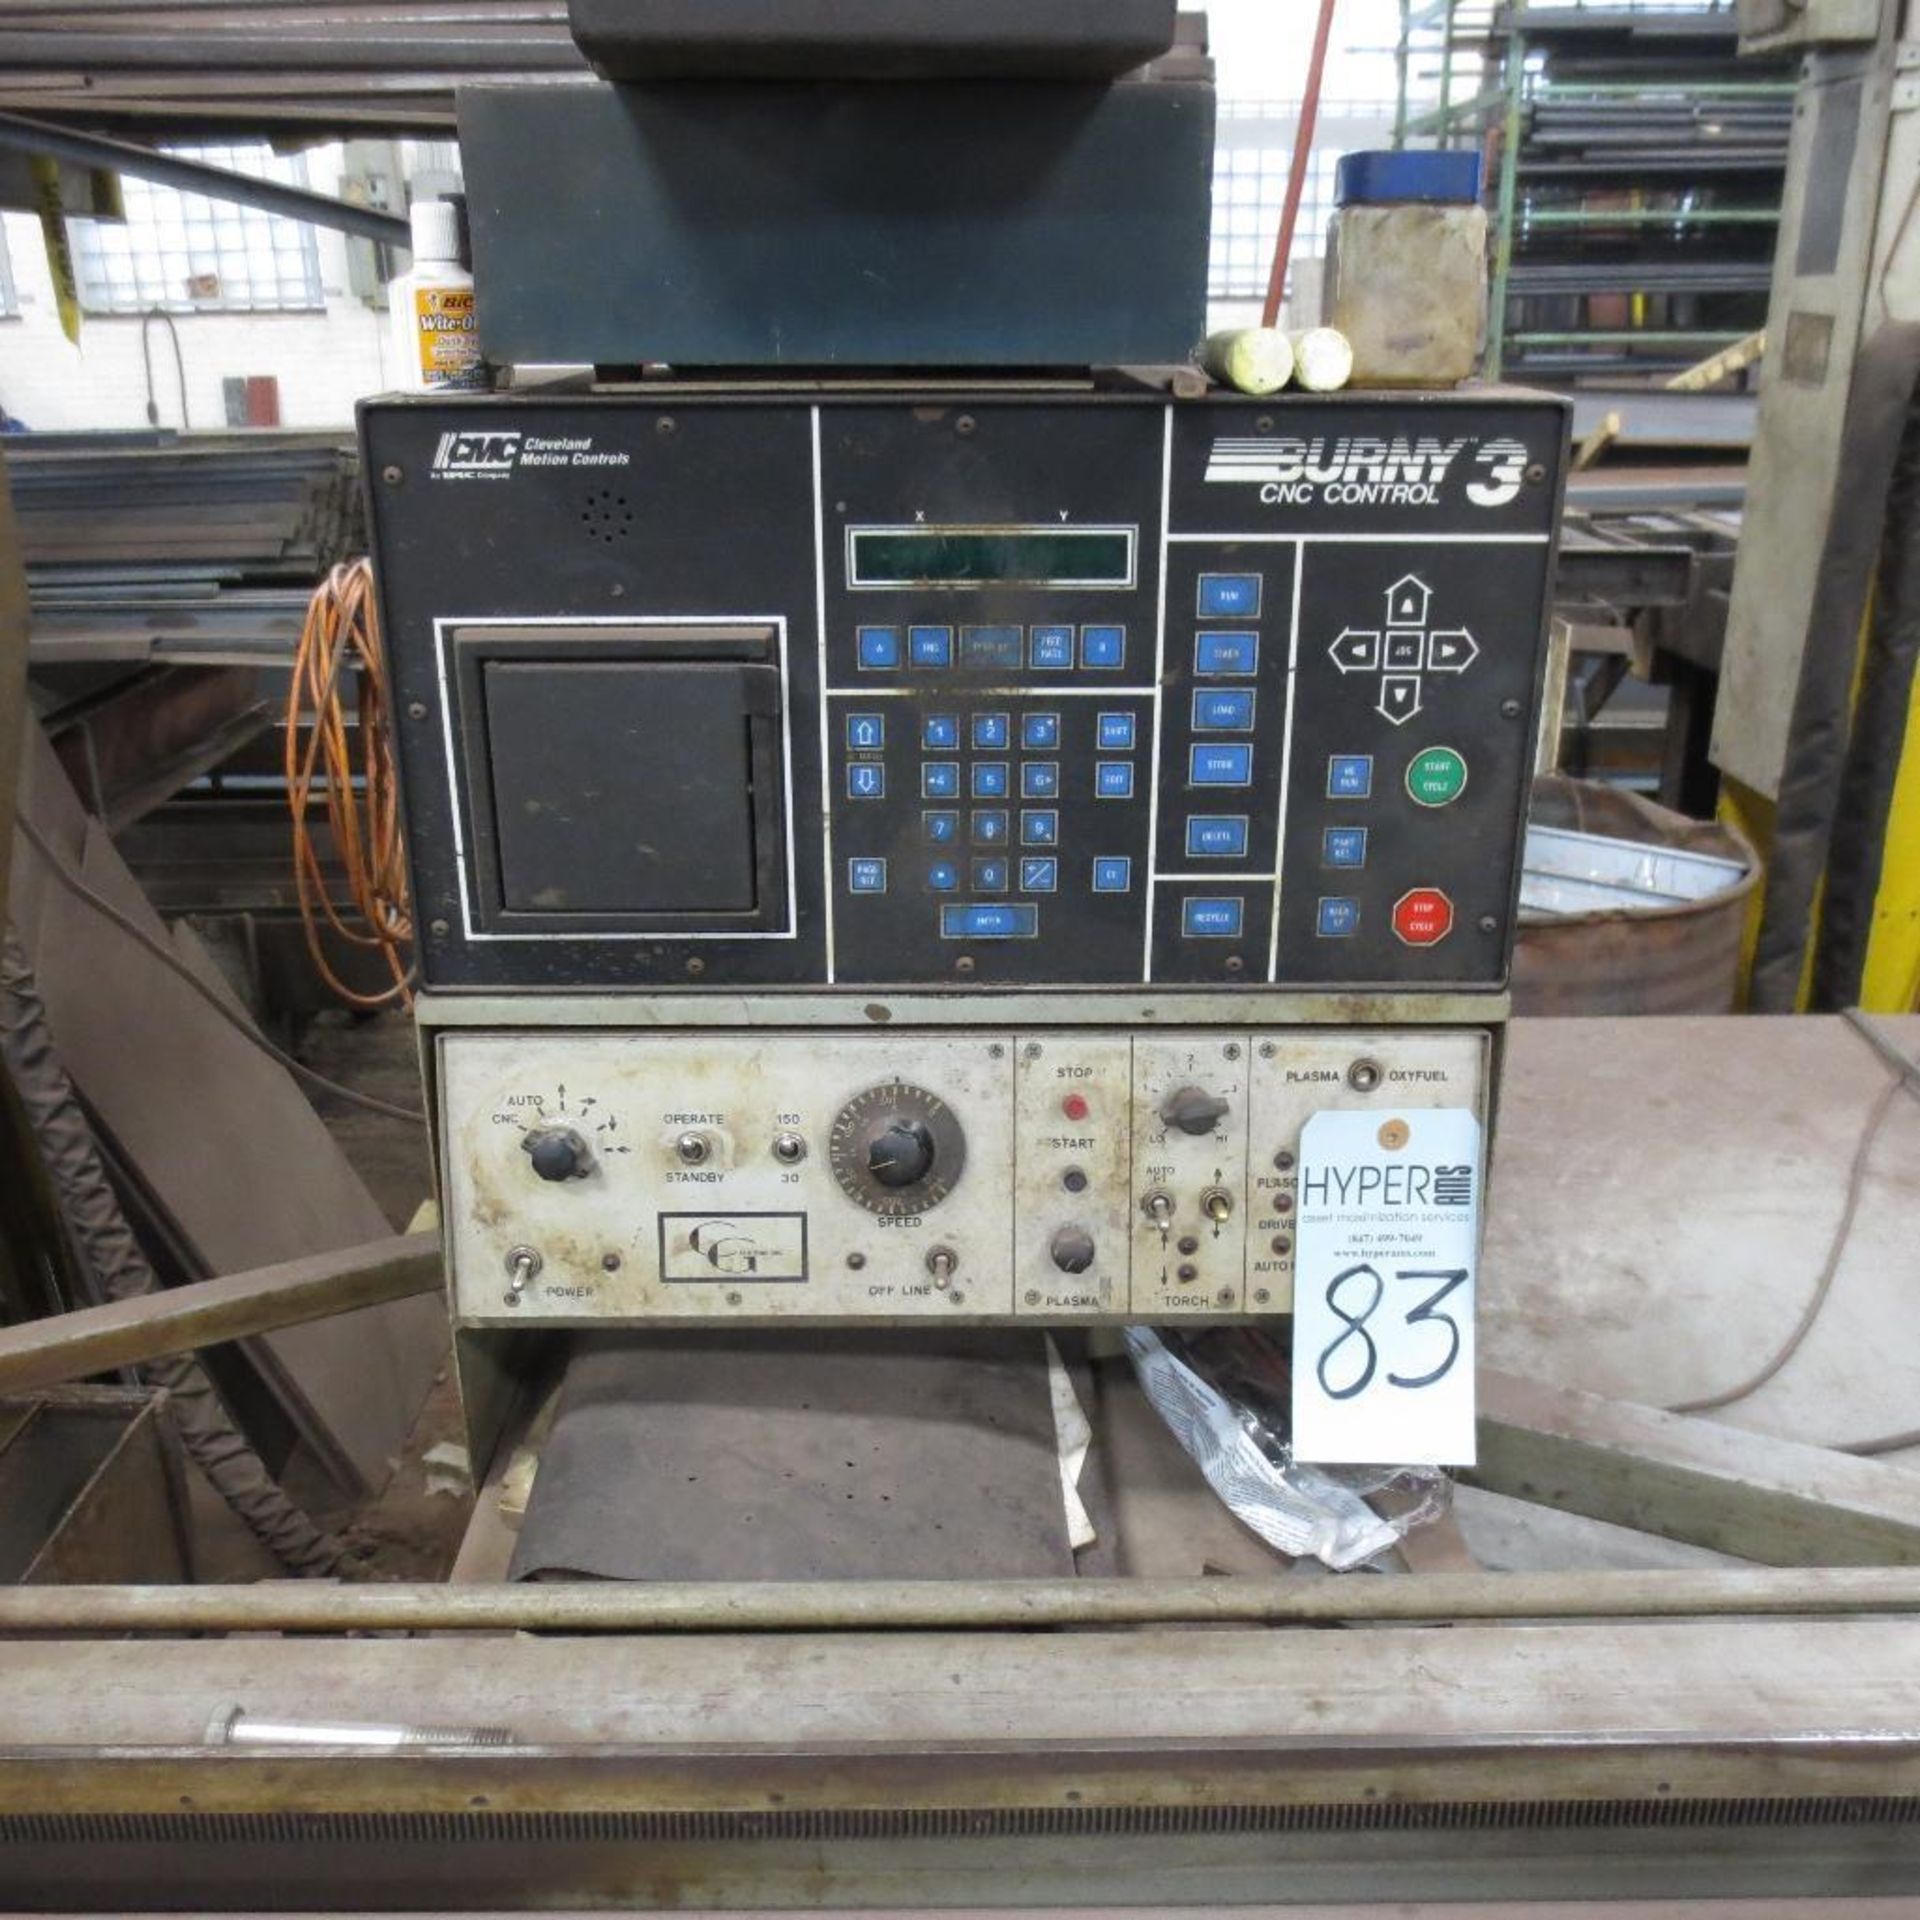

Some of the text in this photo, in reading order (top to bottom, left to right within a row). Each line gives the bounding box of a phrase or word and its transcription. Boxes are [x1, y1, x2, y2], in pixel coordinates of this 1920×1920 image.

[443, 296, 474, 309] BIC
[525, 437, 592, 450] Cleveland
[520, 453, 630, 466] Motion Controls
[1204, 437, 1527, 506] BURNY 3
[1260, 482, 1439, 504] CNC CONTROL
[915, 511, 925, 522] X
[1059, 510, 1069, 522] Y
[937, 726, 944, 737] 1
[986, 727, 995, 738] 2
[1037, 726, 1045, 738] 3
[1425, 762, 1451, 772] START
[936, 775, 945, 785] 4
[986, 775, 995, 786] 5
[1035, 775, 1044, 786] 6
[936, 822, 945, 834] 7
[986, 822, 994, 834] 8
[1035, 822, 1044, 834] 9
[984, 869, 994, 881] 0
[1413, 903, 1434, 913] STOP
[1057, 1067, 1093, 1078] STOP
[1286, 1071, 1340, 1082] PLASMA
[1389, 1071, 1448, 1082] OXYFUEL
[507, 1095, 543, 1107] AUTO
[492, 1114, 519, 1125] CNC
[663, 1113, 725, 1125] OPERATE
[777, 1113, 801, 1125] 150
[1052, 1138, 1095, 1149] START
[1146, 1166, 1175, 1176] AUTO
[665, 1172, 725, 1183] STANDBY
[781, 1173, 800, 1184] 30
[1303, 1164, 1431, 1207] HYPER
[878, 1217, 922, 1228] SPEED
[1302, 1212, 1470, 1224] asset maximization services
[1258, 1219, 1297, 1230] DRIVE
[1254, 1261, 1288, 1272] AUTO
[546, 1286, 594, 1297] POWER
[868, 1285, 932, 1296] OFF LINE
[1046, 1296, 1099, 1306] PLASMA
[1165, 1295, 1209, 1307] TORCH
[1316, 1263, 1469, 1400] 83
